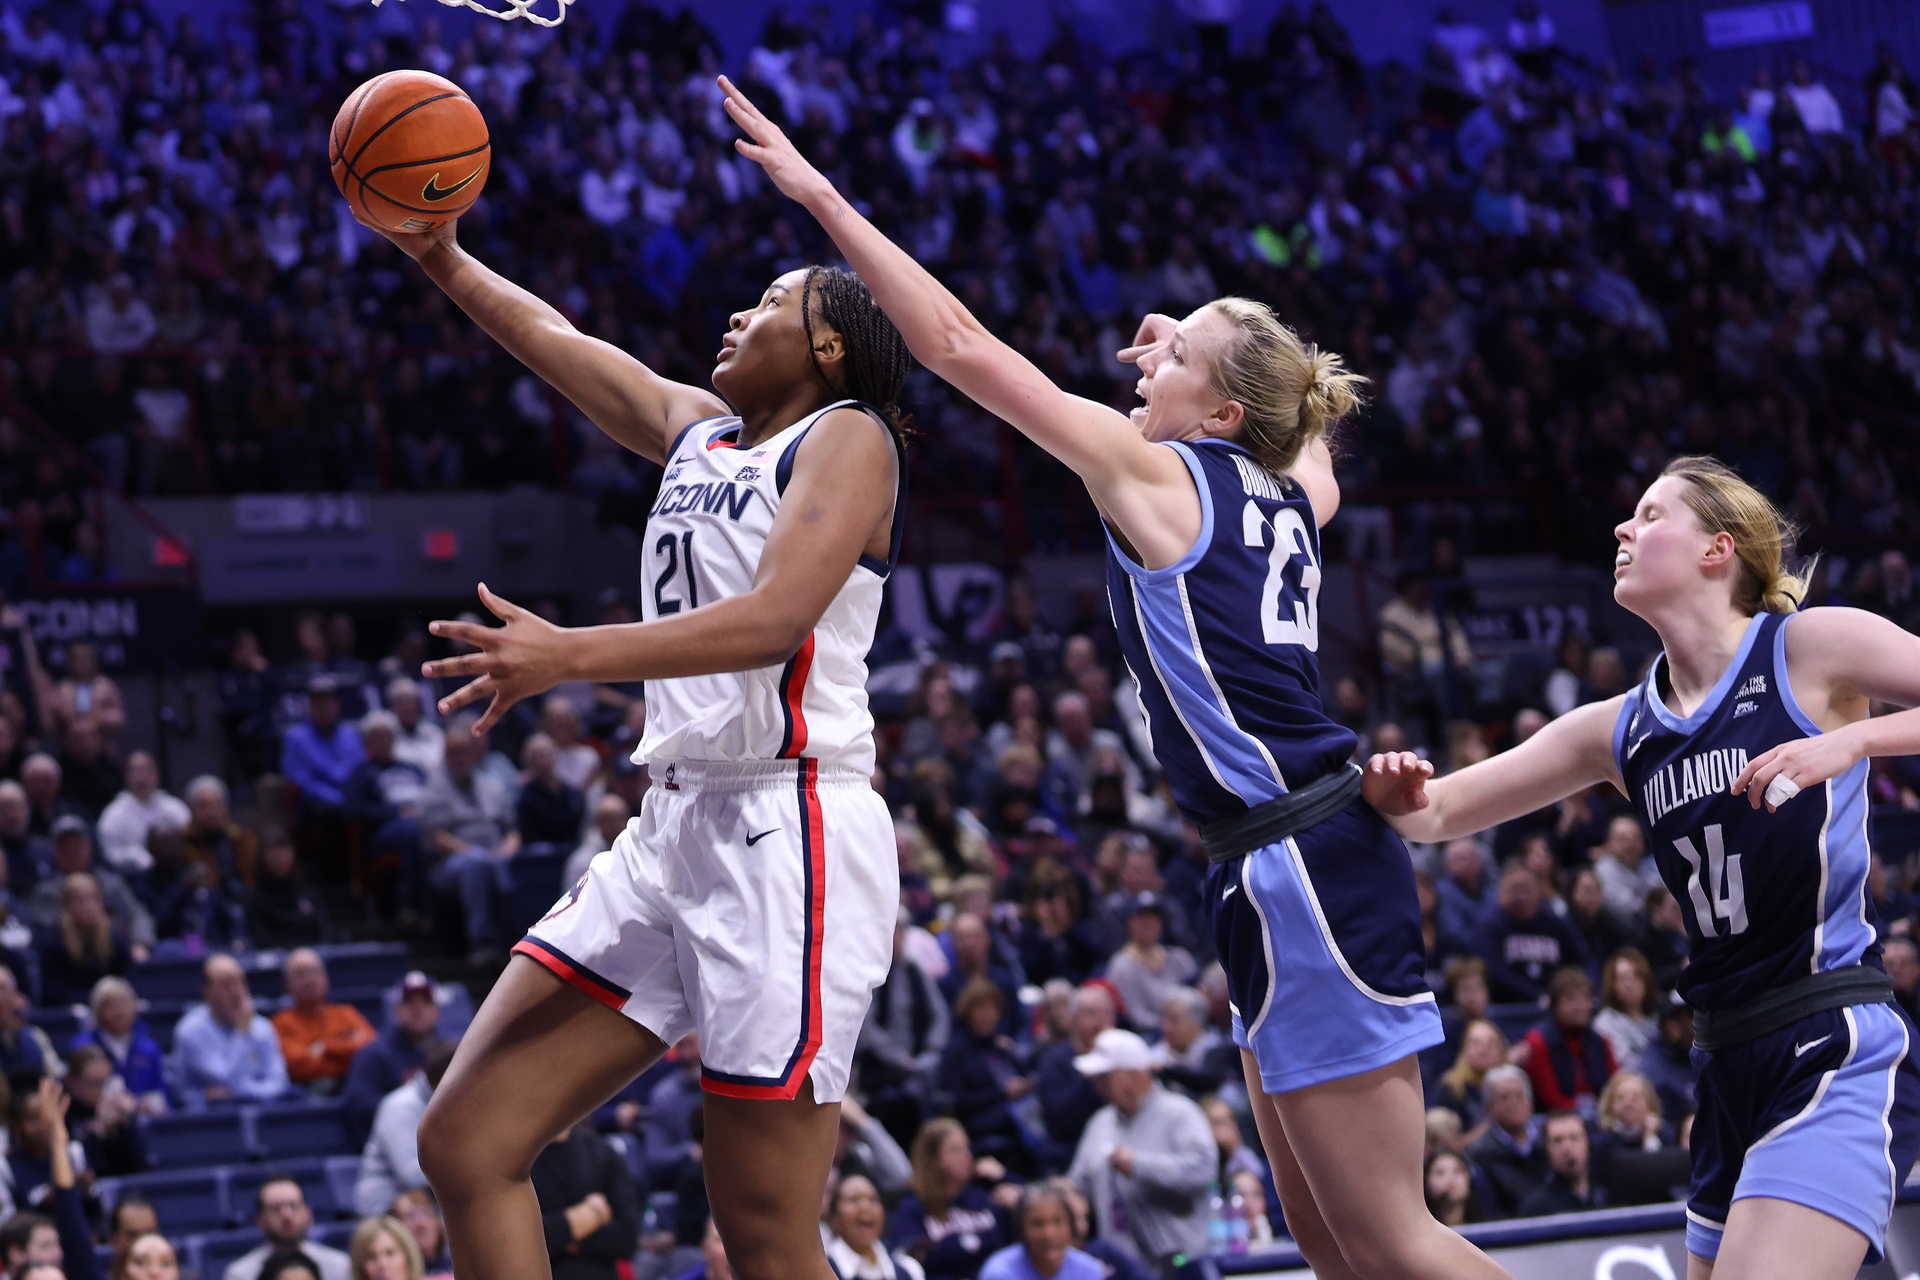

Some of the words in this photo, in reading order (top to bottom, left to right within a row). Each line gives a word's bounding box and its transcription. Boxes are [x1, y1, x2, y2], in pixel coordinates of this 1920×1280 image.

[734, 473, 761, 481] EAST
[654, 530, 699, 617] 21
[1242, 499, 1321, 652] 23
[14, 599, 138, 640] CONN
[1749, 675, 1765, 686] THE
[1643, 747, 1752, 828] VILLANOVA
[1672, 823, 1749, 939] 14
